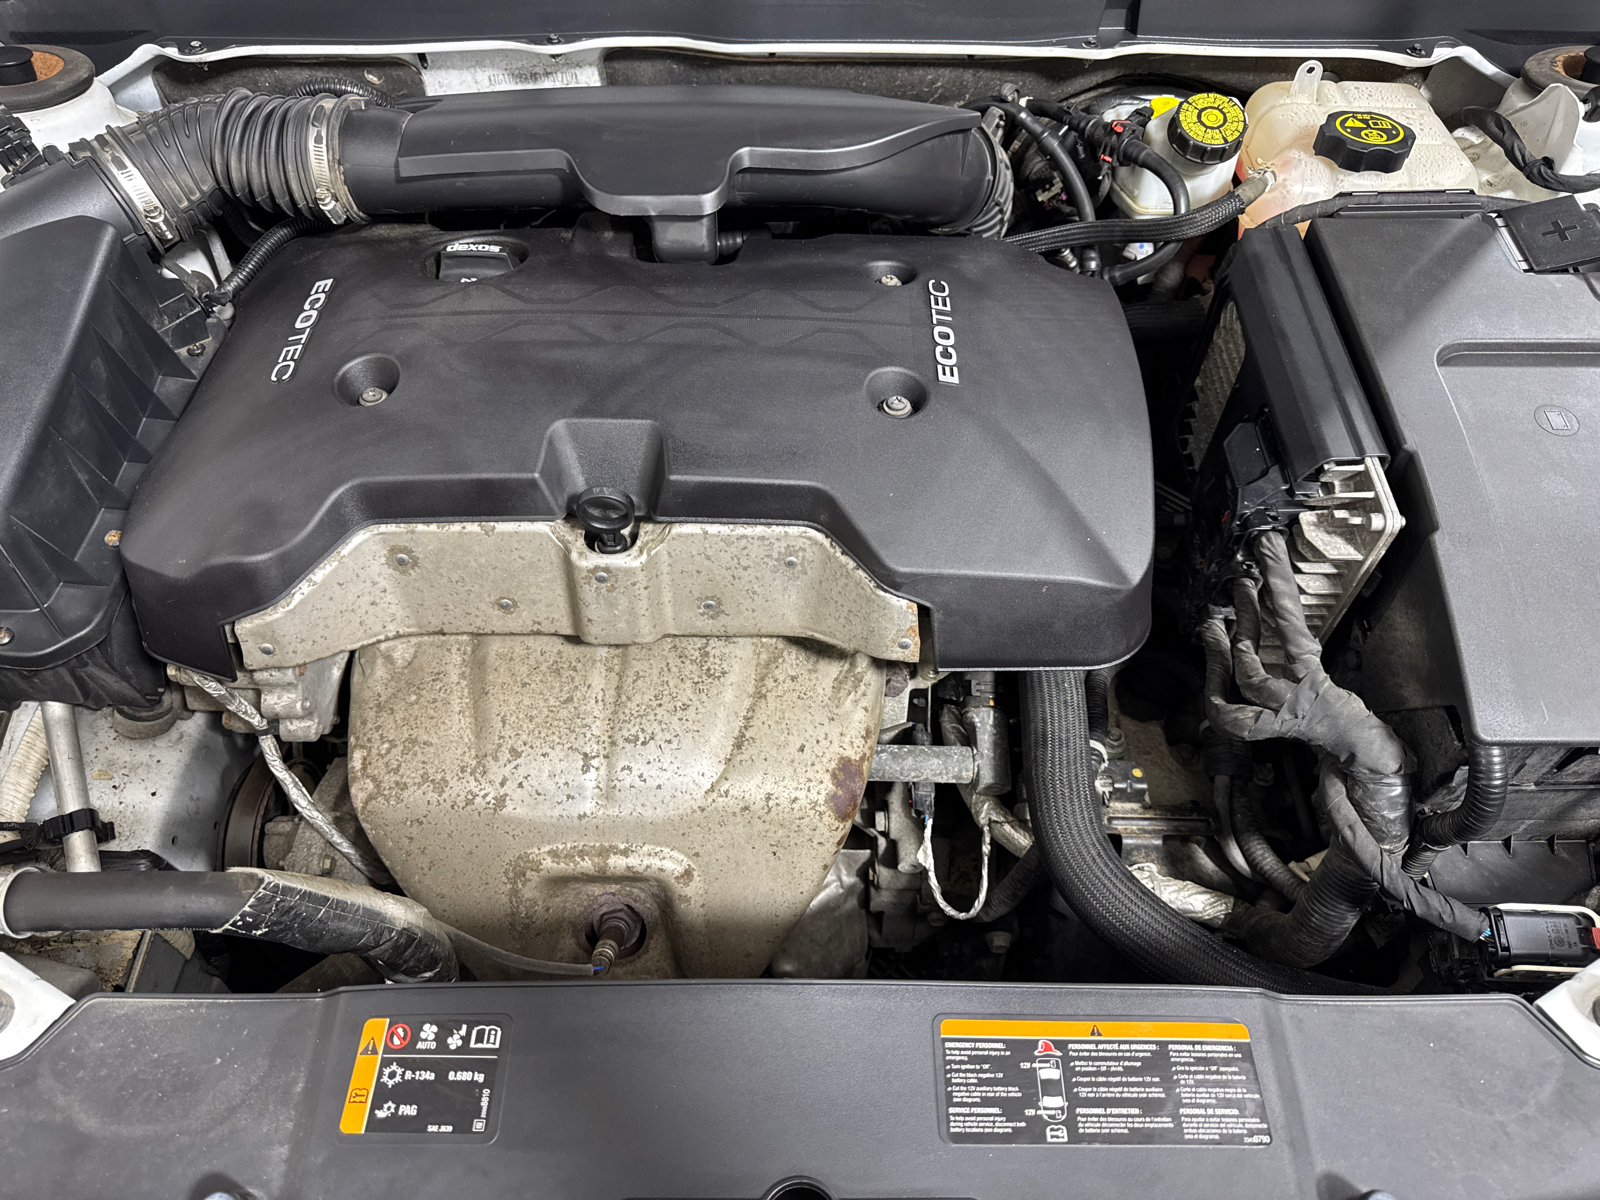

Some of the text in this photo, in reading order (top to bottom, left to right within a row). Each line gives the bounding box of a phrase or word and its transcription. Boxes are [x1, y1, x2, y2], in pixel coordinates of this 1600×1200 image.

[446, 243, 502, 252] dexos
[270, 278, 334, 382] ECOTEC
[928, 279, 960, 384] ECOTEC
[416, 1041, 437, 1049] AUTO
[404, 1070, 485, 1083] R-134a 0.680 kg
[399, 1105, 418, 1116] PAG
